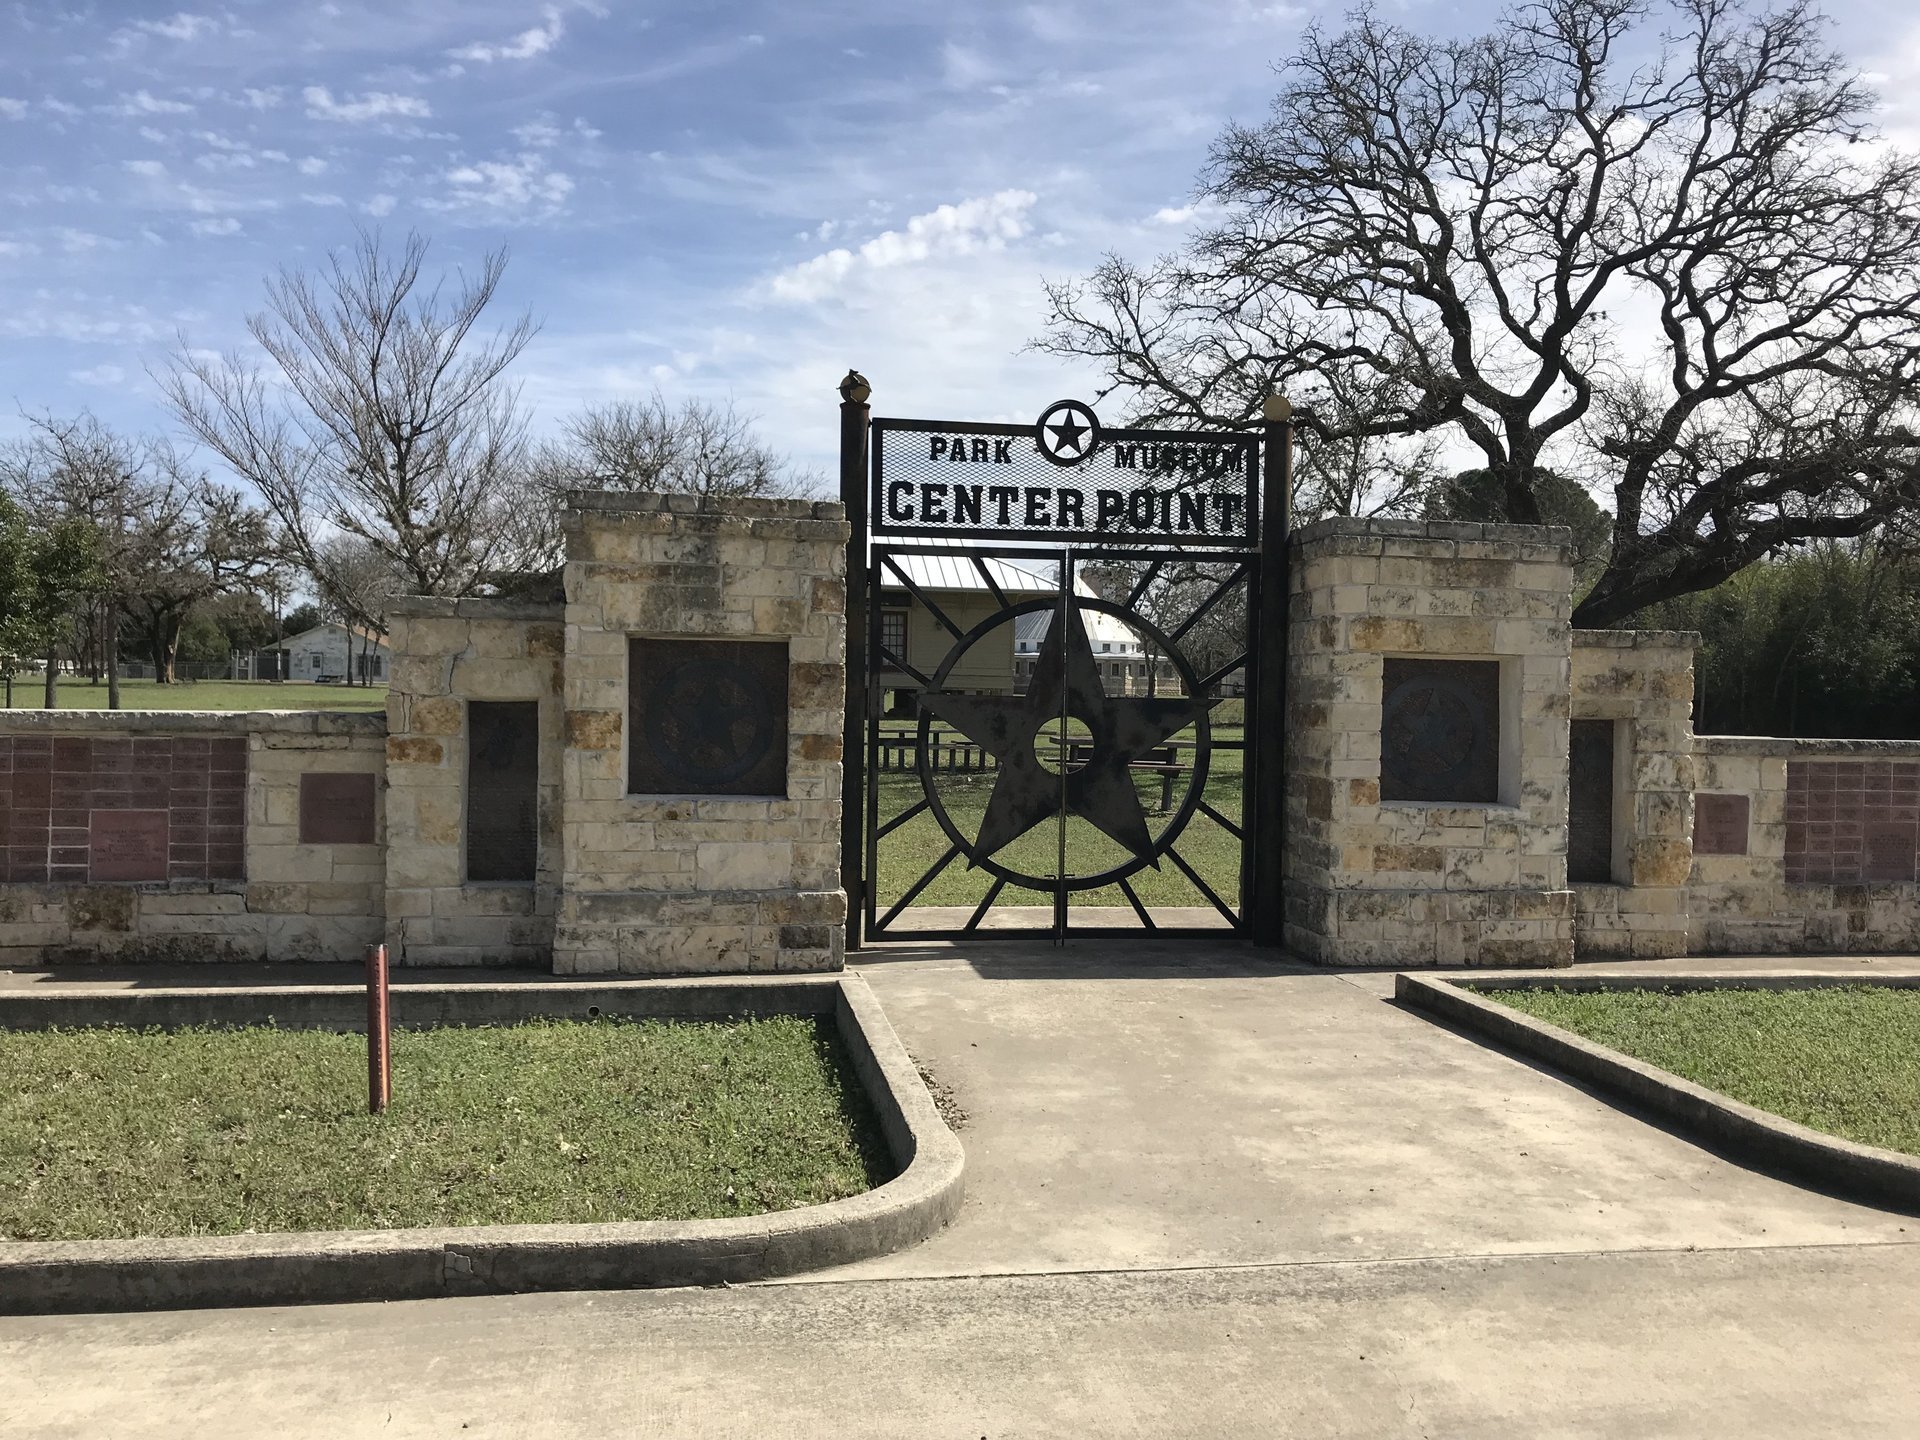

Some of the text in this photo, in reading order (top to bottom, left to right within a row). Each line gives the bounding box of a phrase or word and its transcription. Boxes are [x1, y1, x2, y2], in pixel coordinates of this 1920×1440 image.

[929, 436, 1243, 473] PARK MUSEUM
[888, 480, 1242, 532] CENTER POINT
